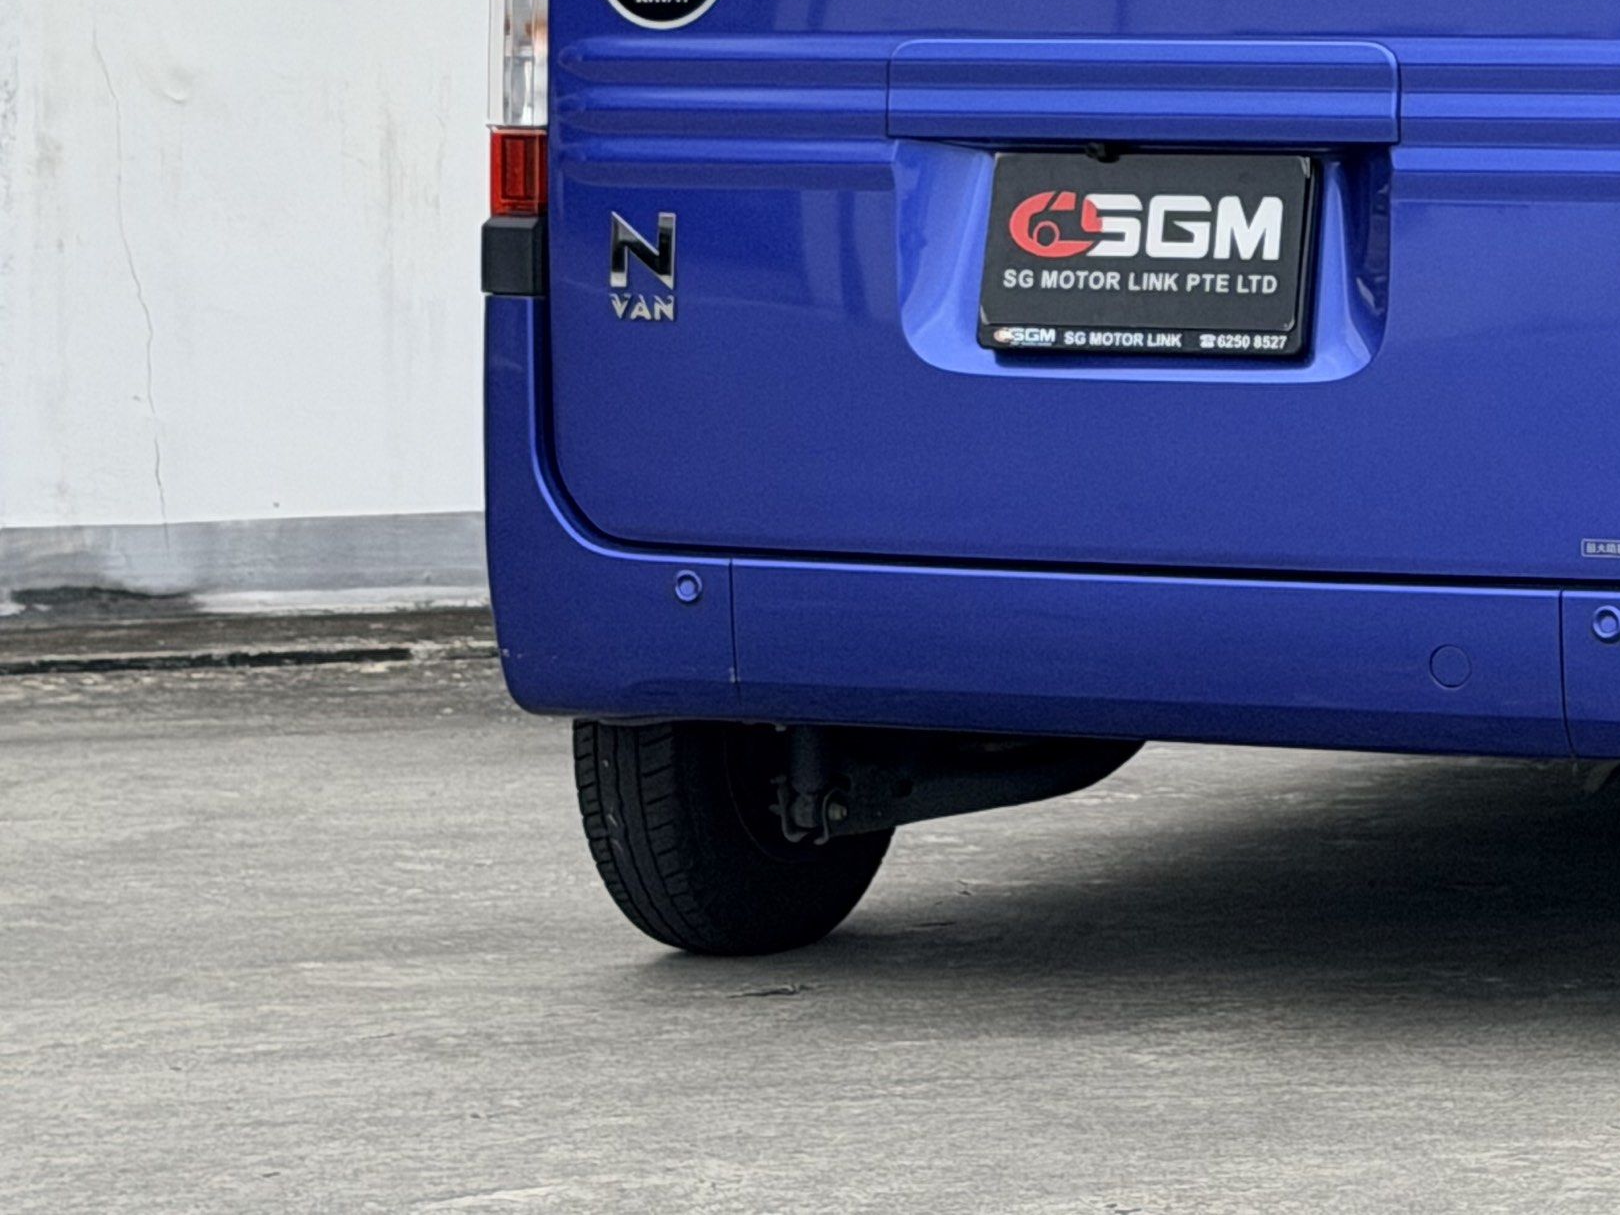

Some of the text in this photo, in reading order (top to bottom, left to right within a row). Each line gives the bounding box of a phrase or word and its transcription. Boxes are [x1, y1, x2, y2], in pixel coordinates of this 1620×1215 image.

[1081, 193, 1284, 261] SGM
[610, 211, 677, 290] N
[1003, 269, 1278, 294] SG MOTOR LINK PTE LTD
[609, 293, 676, 321] VAN
[1009, 327, 1056, 343] SGM
[1064, 331, 1087, 346] SG
[1089, 332, 1145, 347] MOTOR
[1147, 333, 1183, 348] LINK
[1253, 334, 1288, 350] 8527
